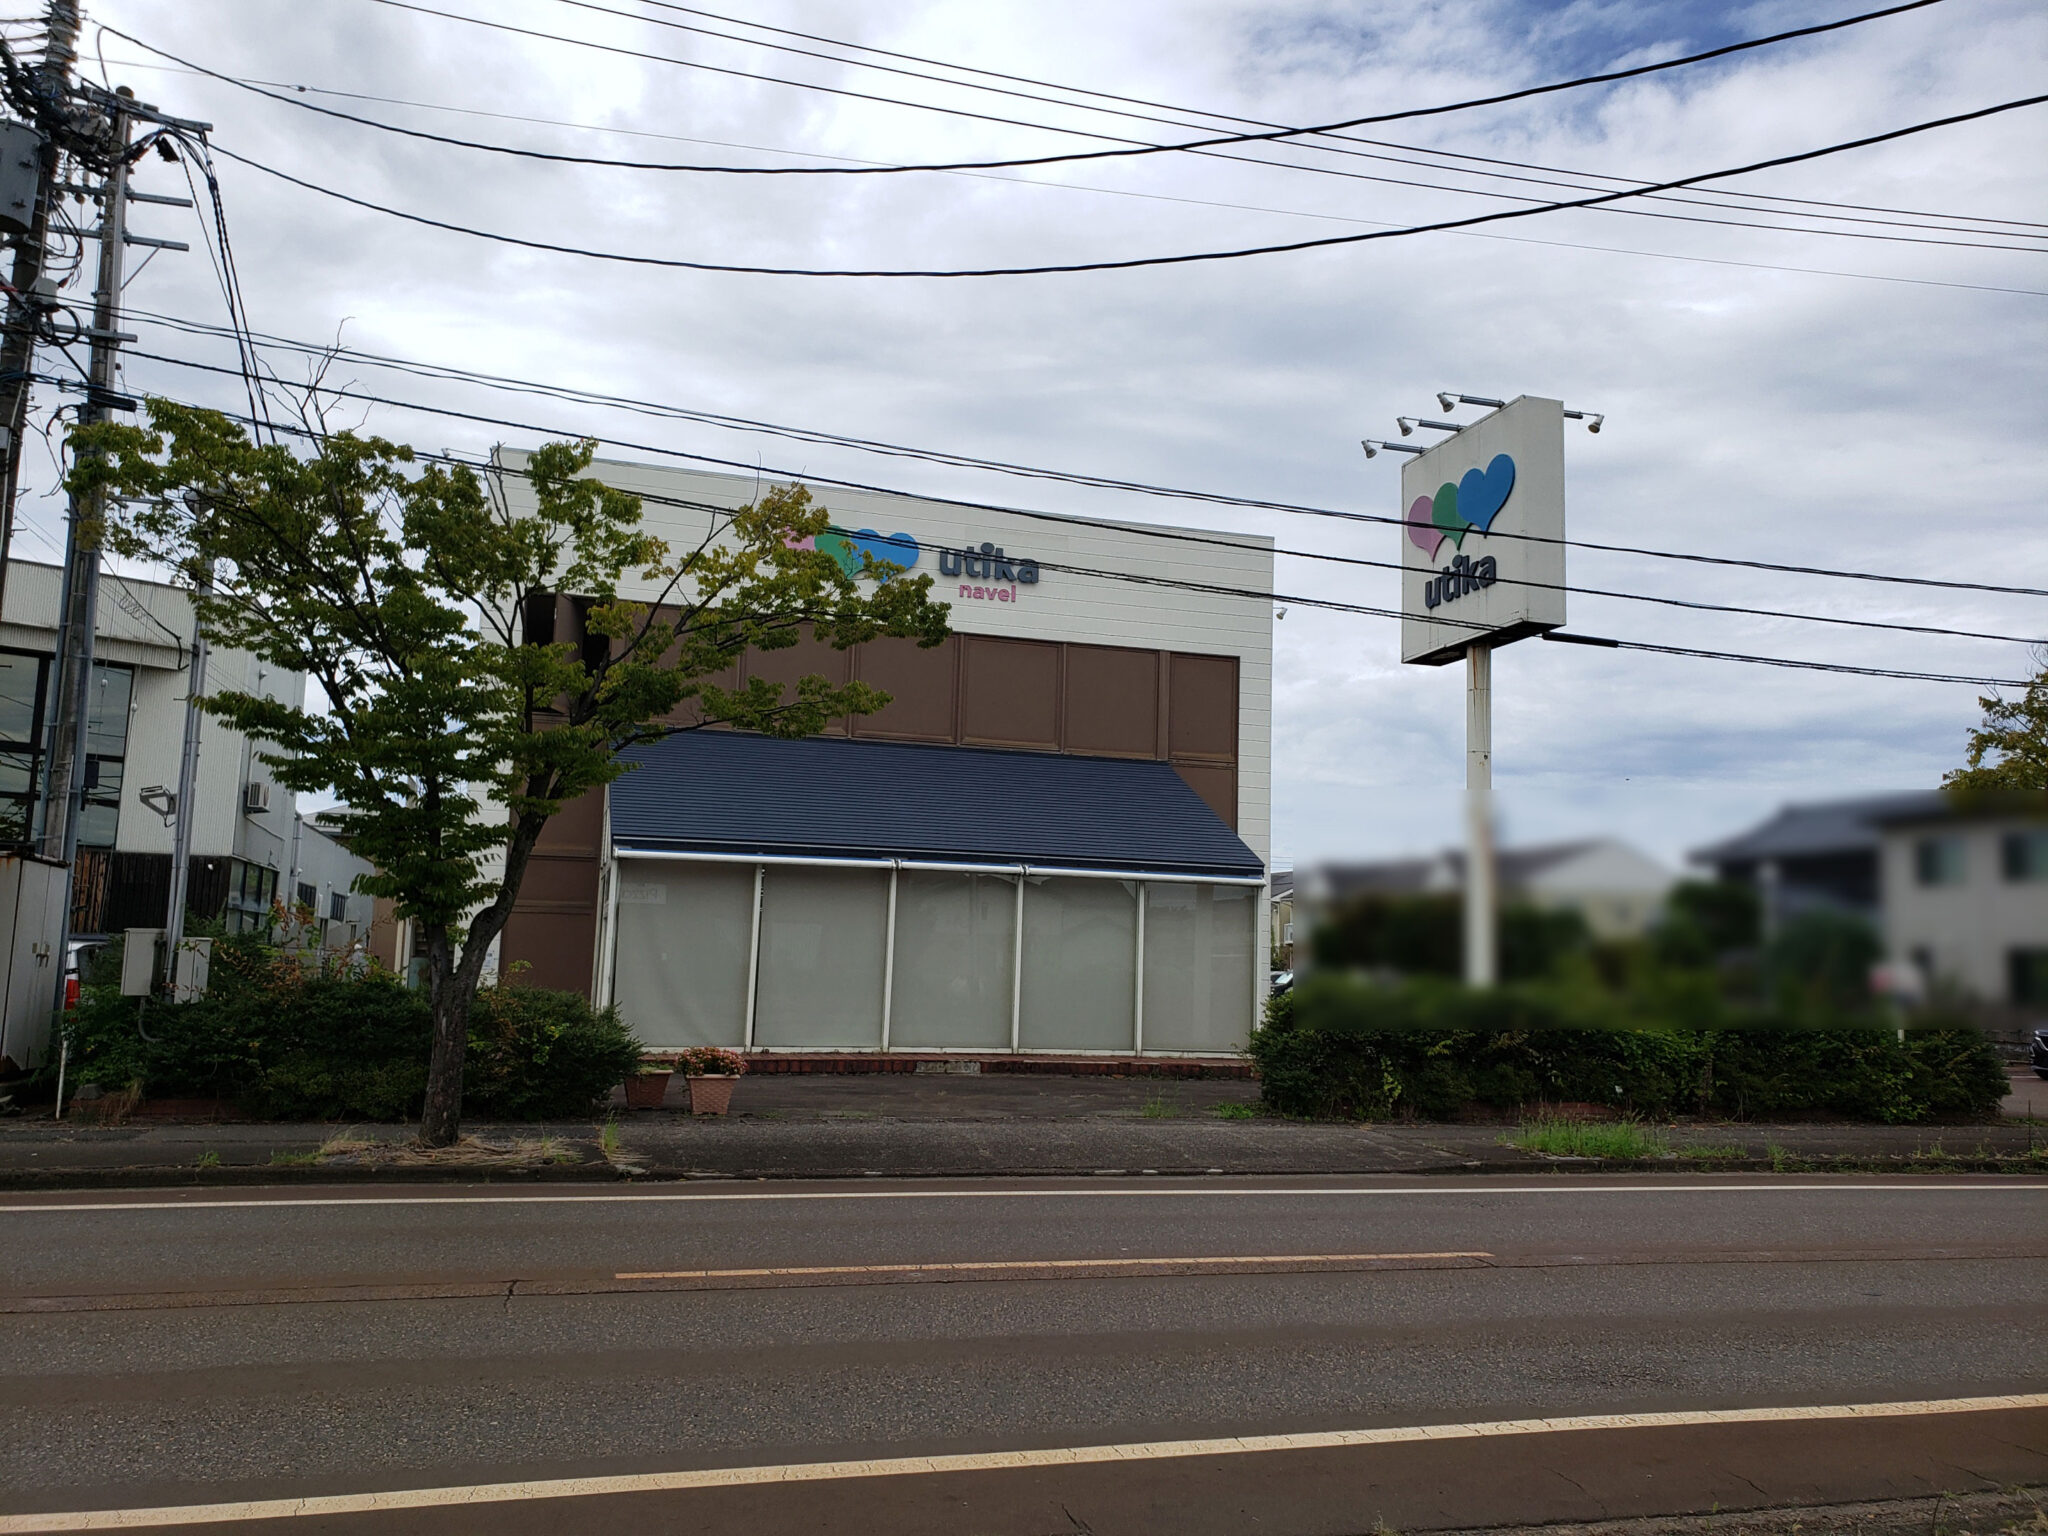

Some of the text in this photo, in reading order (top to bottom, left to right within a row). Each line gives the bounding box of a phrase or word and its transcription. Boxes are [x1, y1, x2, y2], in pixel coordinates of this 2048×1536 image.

[940, 542, 1039, 583] utika
[1425, 554, 1496, 609] utika
[959, 584, 1016, 602] navel
